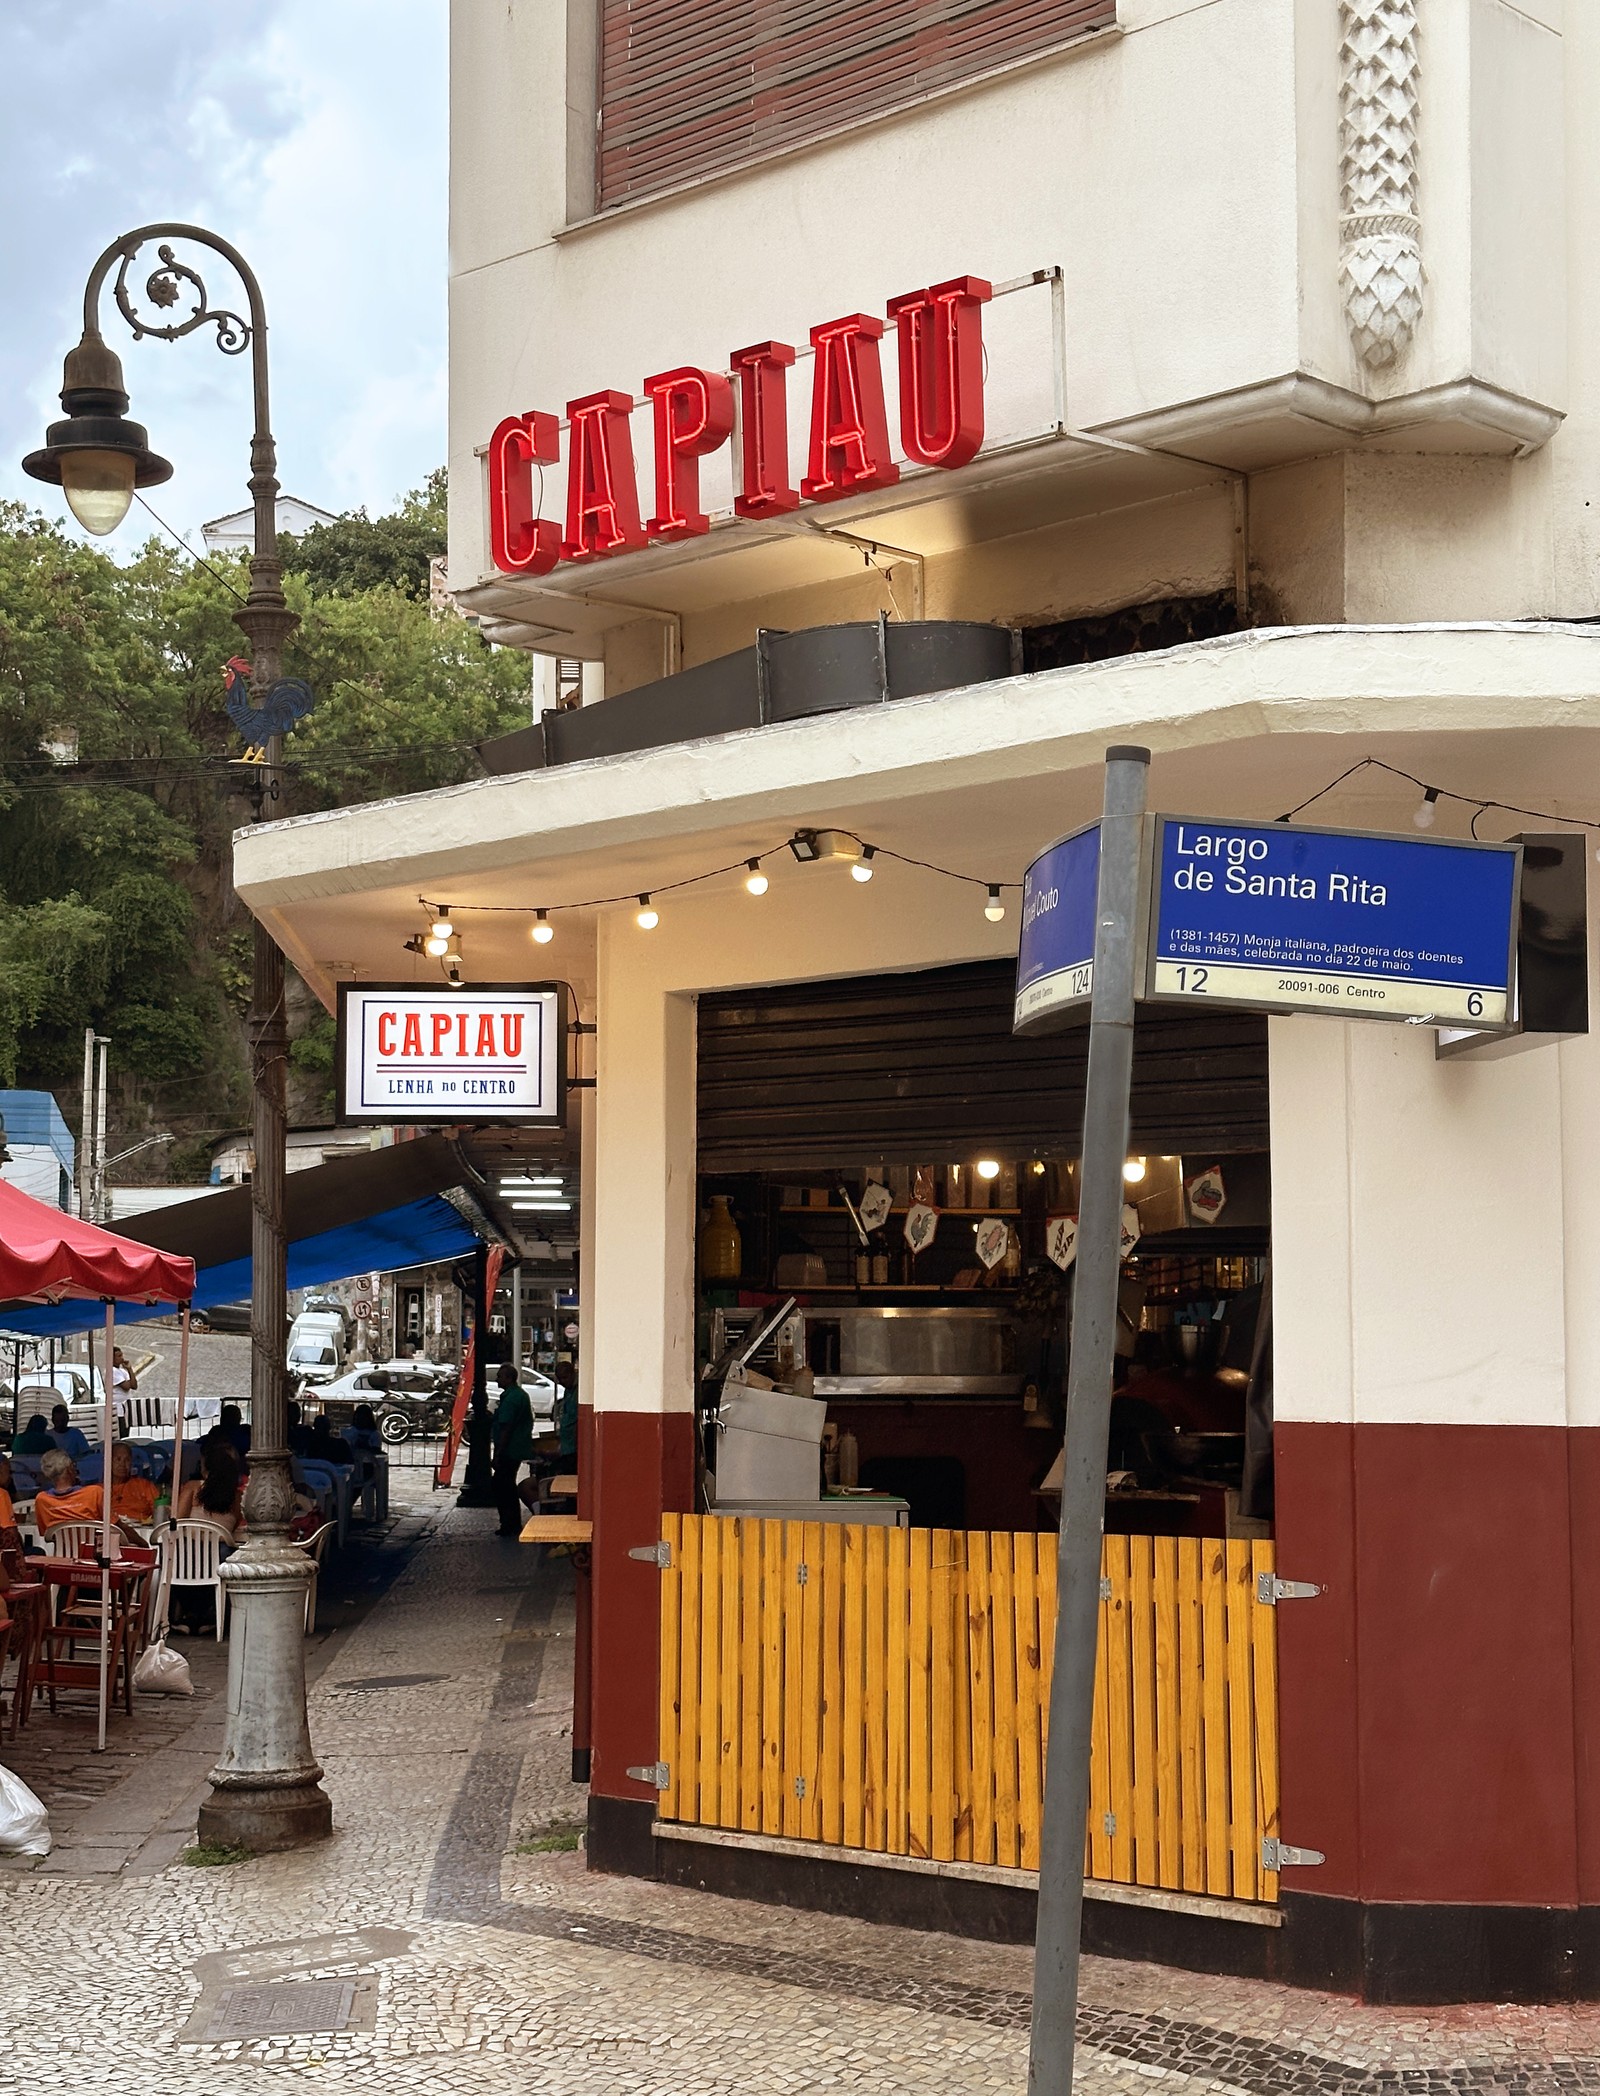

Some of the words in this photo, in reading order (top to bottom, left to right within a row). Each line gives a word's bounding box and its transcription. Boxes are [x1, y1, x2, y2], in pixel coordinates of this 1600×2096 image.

[489, 275, 992, 577] CAPIAU
[1177, 826, 1269, 866] Largo
[1036, 886, 1059, 917] Couto
[1173, 863, 1214, 892] de
[1224, 866, 1317, 900] Santa
[1328, 873, 1388, 906] Rita
[1169, 943, 1177, 952] e
[1180, 942, 1201, 954] das
[1205, 944, 1241, 958] mães,
[1244, 947, 1302, 962] celebrada
[1306, 952, 1322, 963] no
[1325, 952, 1343, 965] dia
[1346, 954, 1361, 967] 22
[1364, 956, 1379, 968] de
[1382, 959, 1414, 972] maio.
[1170, 929, 1240, 946] (1381-1457)
[1244, 934, 1281, 948] Monja
[1285, 936, 1330, 952] italiana,
[1334, 943, 1390, 957] padroeira
[1393, 947, 1415, 960] dos
[1417, 950, 1464, 965] doentes
[1072, 967, 1089, 995] 124
[1176, 966, 1209, 994] 12
[1278, 979, 1340, 995] 20091-006
[1346, 985, 1386, 999] Centro
[1467, 991, 1484, 1017] 6
[378, 1011, 525, 1058] CAPIAU
[388, 1079, 434, 1094] LENHA
[442, 1081, 457, 1092] no
[463, 1079, 516, 1095] CENTRO
